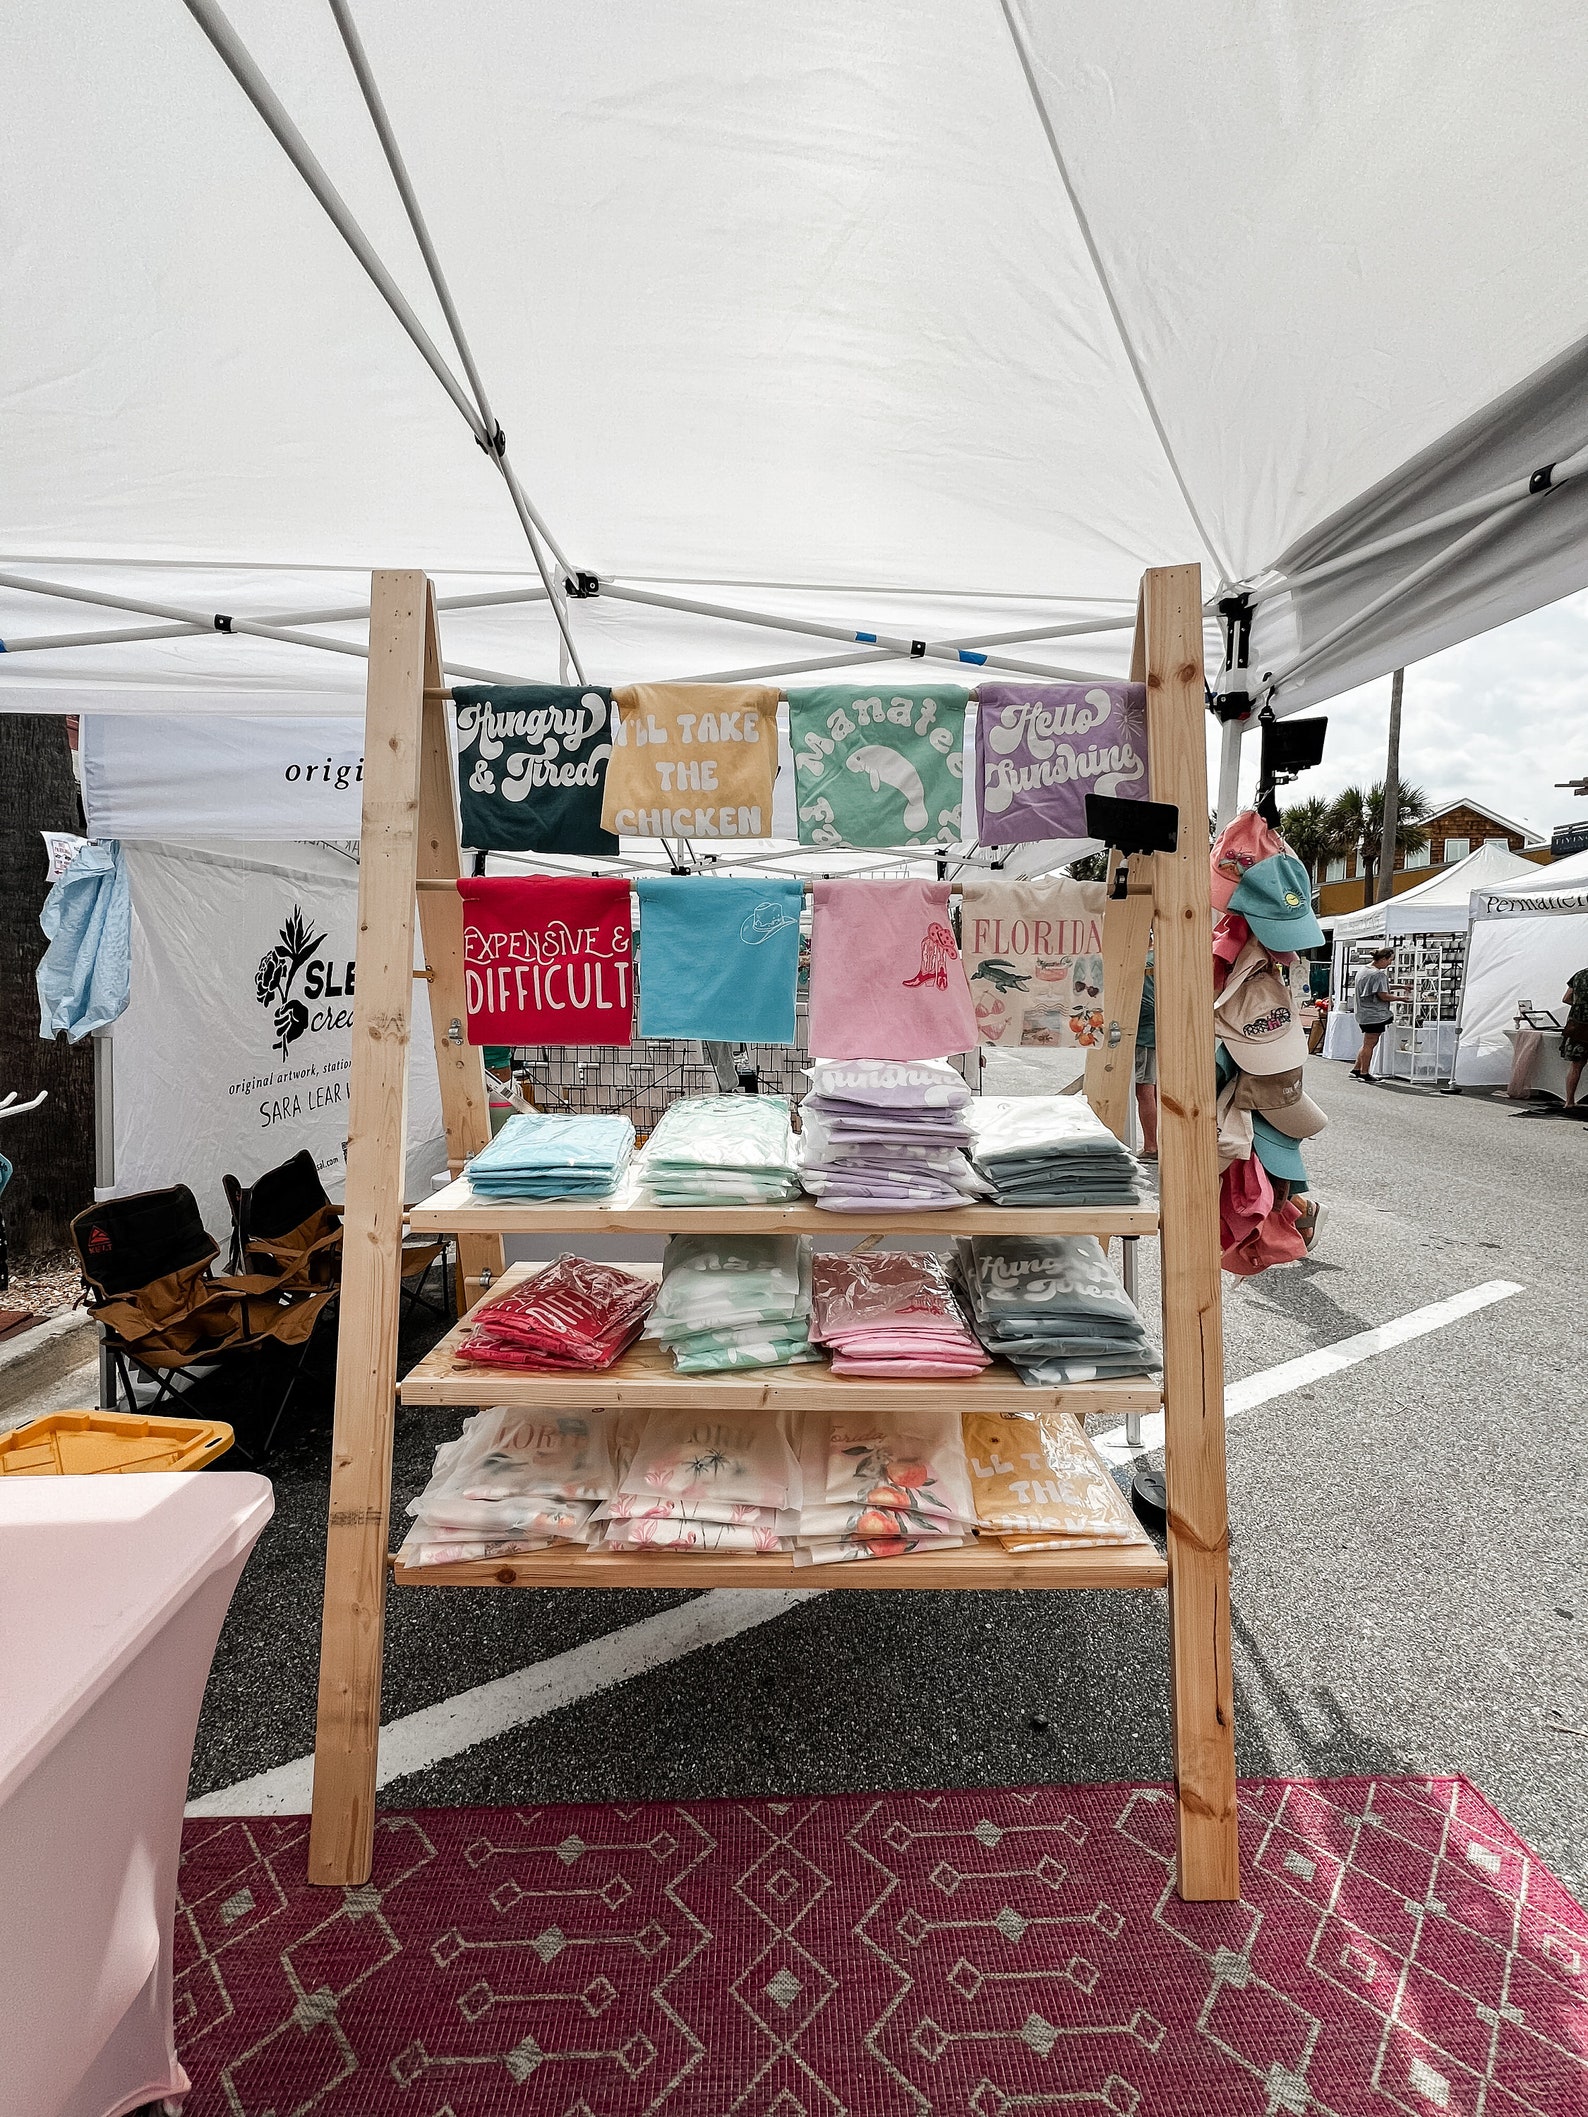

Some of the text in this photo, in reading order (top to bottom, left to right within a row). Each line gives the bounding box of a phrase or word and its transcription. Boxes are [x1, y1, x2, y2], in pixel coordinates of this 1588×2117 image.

[457, 693, 607, 760] Hungry
[677, 712, 760, 744] TAKE
[989, 688, 1111, 760] Hello
[469, 738, 612, 802] & Tired
[655, 760, 719, 792] THE
[985, 742, 1146, 813] Sunshine
[615, 805, 762, 837] CHICKEN
[464, 920, 630, 966] EXPENSIVE &
[971, 918, 1103, 955] FLORIDA
[465, 962, 630, 1015] DIFFICULT
[228, 1071, 274, 1096] original
[276, 1063, 319, 1083] artwork,
[259, 1082, 342, 1128] SARA LEAR
